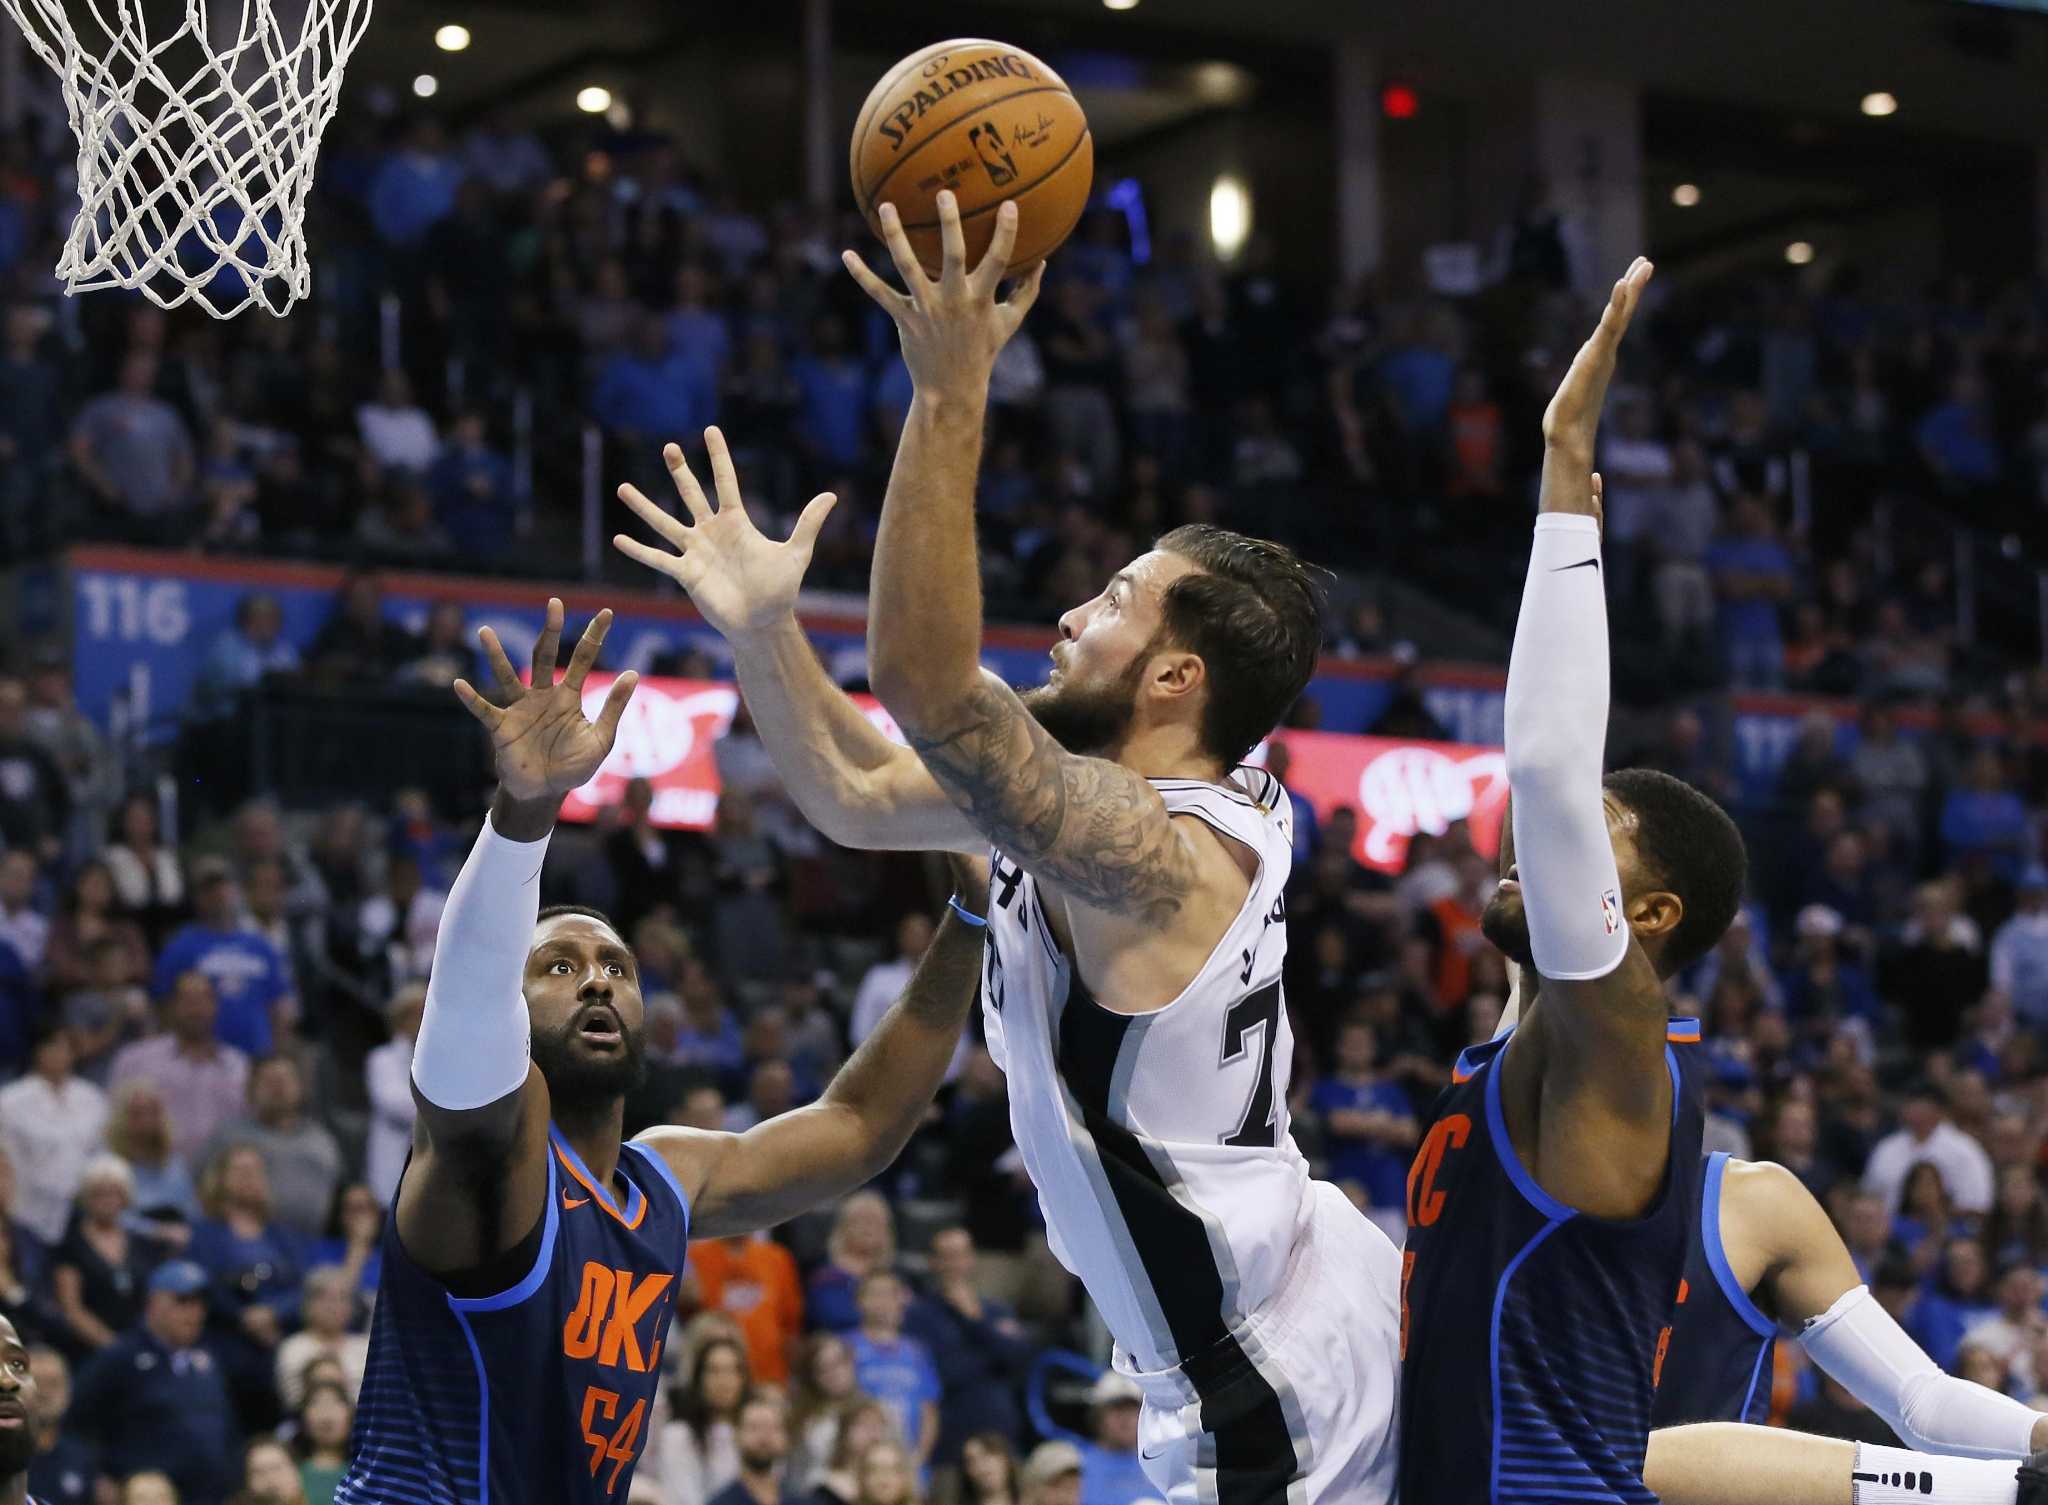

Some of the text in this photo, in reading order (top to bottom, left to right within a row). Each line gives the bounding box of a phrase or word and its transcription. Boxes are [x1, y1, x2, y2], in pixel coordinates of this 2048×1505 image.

[880, 55, 1033, 151] SPALDING
[81, 575, 189, 643] 116
[1218, 974, 1281, 1147] 7
[564, 1262, 674, 1372] OK
[581, 1387, 647, 1494] 54
